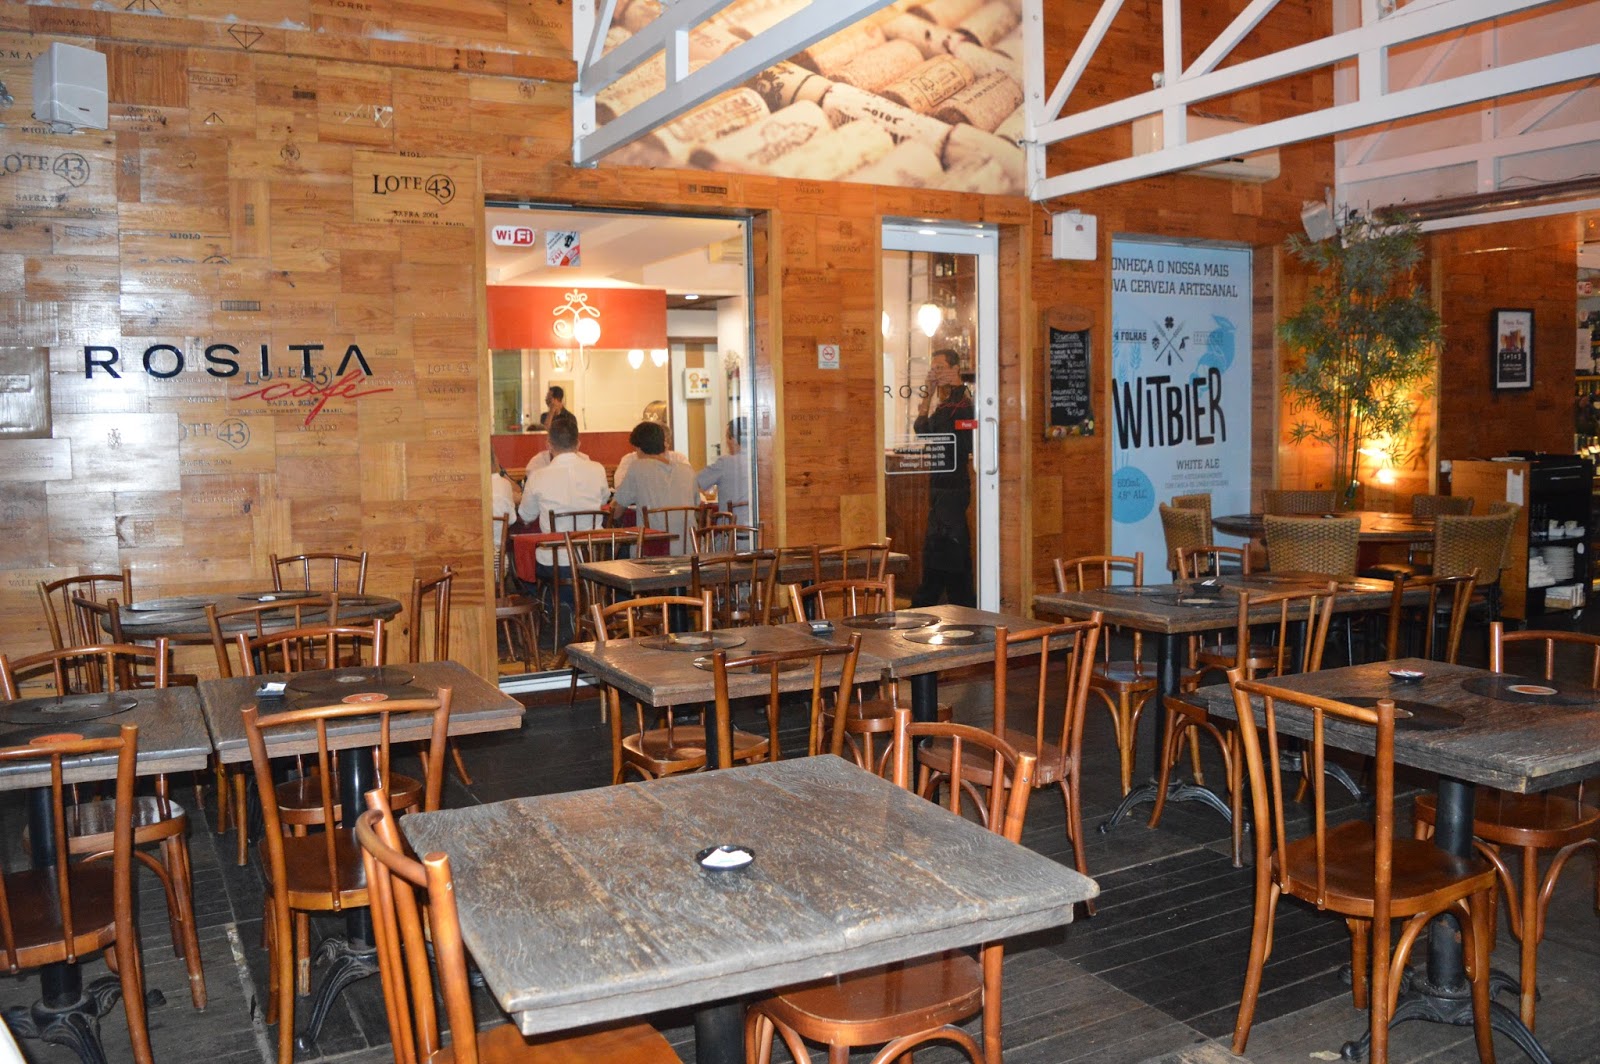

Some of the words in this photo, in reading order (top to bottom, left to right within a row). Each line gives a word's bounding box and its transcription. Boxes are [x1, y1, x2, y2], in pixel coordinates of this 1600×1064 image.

[0, 153, 49, 177] OTE
[55, 156, 87, 183] 43
[372, 174, 422, 195] LOTE
[427, 177, 453, 201] 43
[169, 232, 201, 241] MIOLO
[1157, 260, 1164, 274] O
[1167, 261, 1202, 276] NOSSA
[1204, 263, 1230, 277] MAIS
[1130, 279, 1176, 295] CERVEJA
[1178, 282, 1238, 298] ARTESANAL
[1120, 331, 1147, 341] FOLHAS
[84, 344, 373, 379] ROSITA
[230, 369, 394, 427] café
[266, 399, 294, 407] SAFRA
[218, 421, 247, 446] 43
[295, 423, 337, 432] VALLADO
[1176, 459, 1202, 470] WHITE
[1205, 458, 1220, 469] ALE
